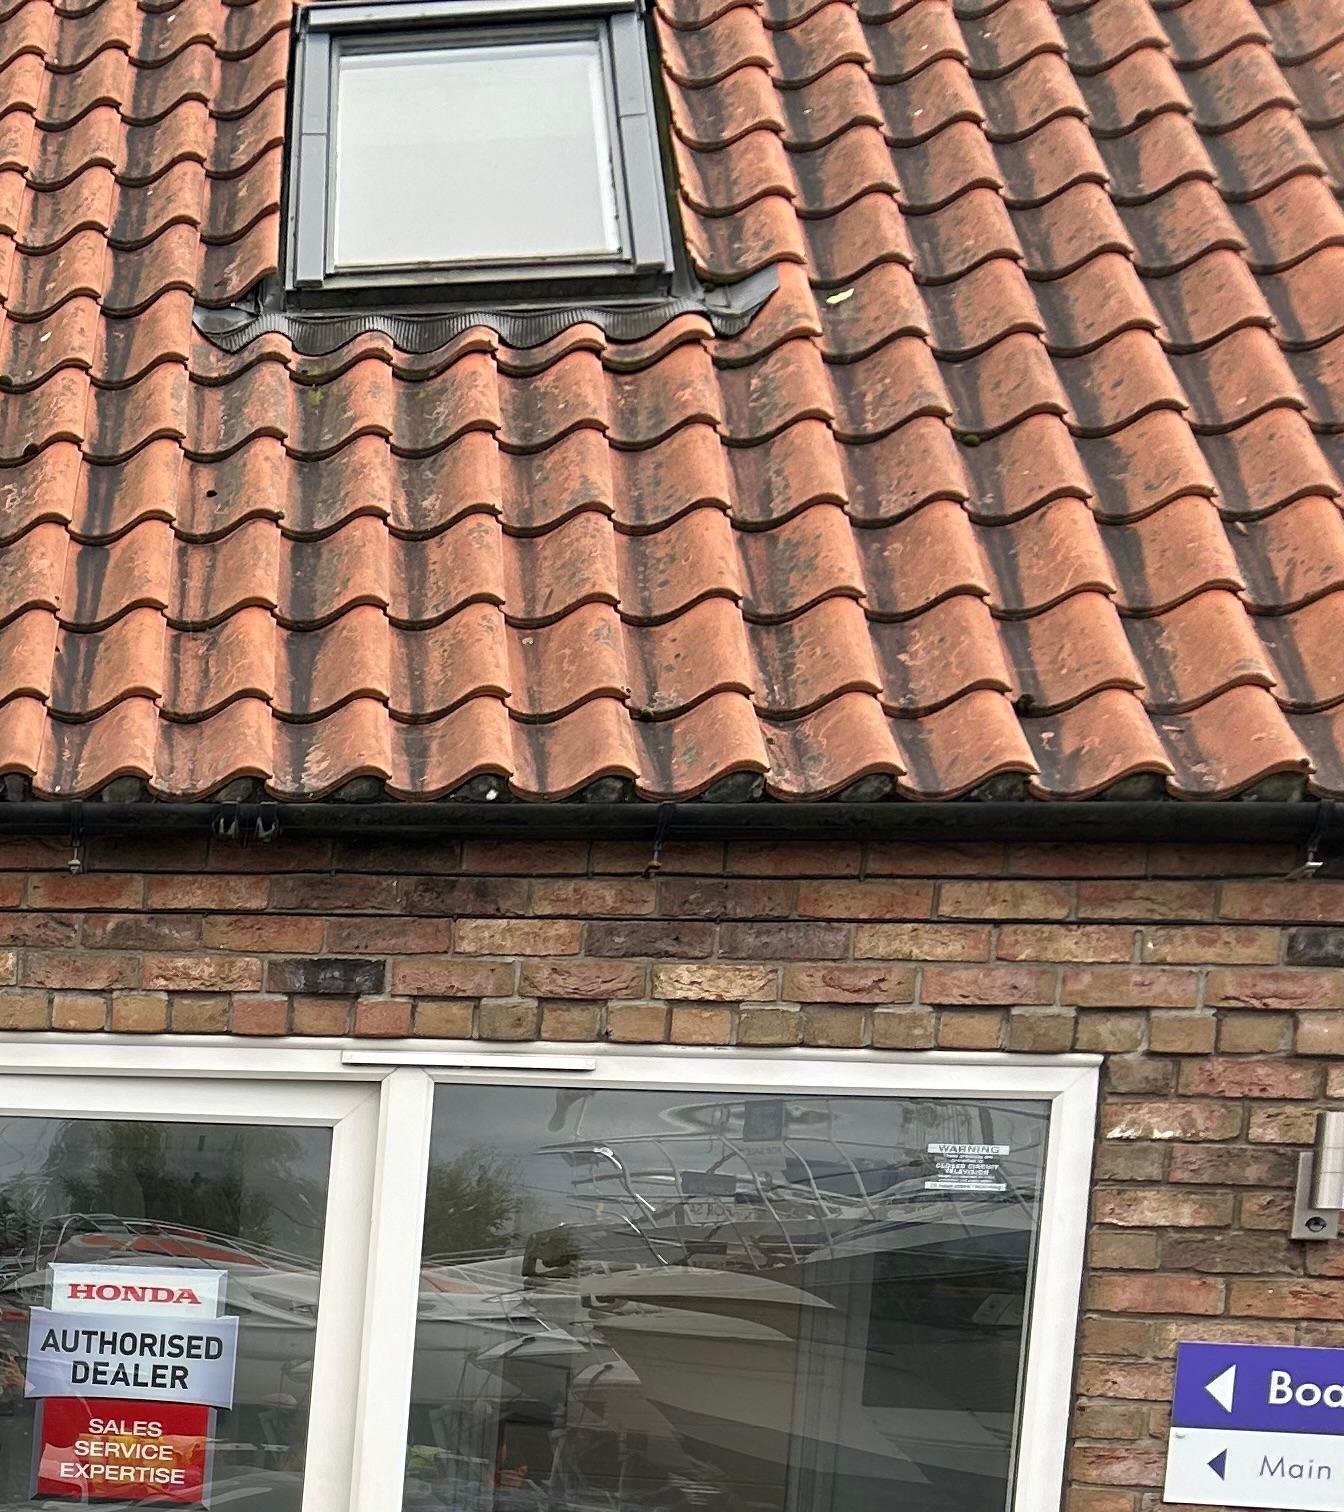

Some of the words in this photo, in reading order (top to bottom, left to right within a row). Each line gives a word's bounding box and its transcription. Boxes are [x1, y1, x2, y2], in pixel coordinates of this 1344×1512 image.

[938, 1144, 1000, 1154] WARNING
[66, 1282, 202, 1305] HONDA
[40, 1328, 224, 1361] AUTHORISED
[70, 1360, 190, 1390] DEALER
[88, 1418, 163, 1437] SALES
[74, 1440, 174, 1461] SERVICE
[60, 1462, 185, 1485] EXPERTISE
[1259, 1455, 1332, 1481] Main
